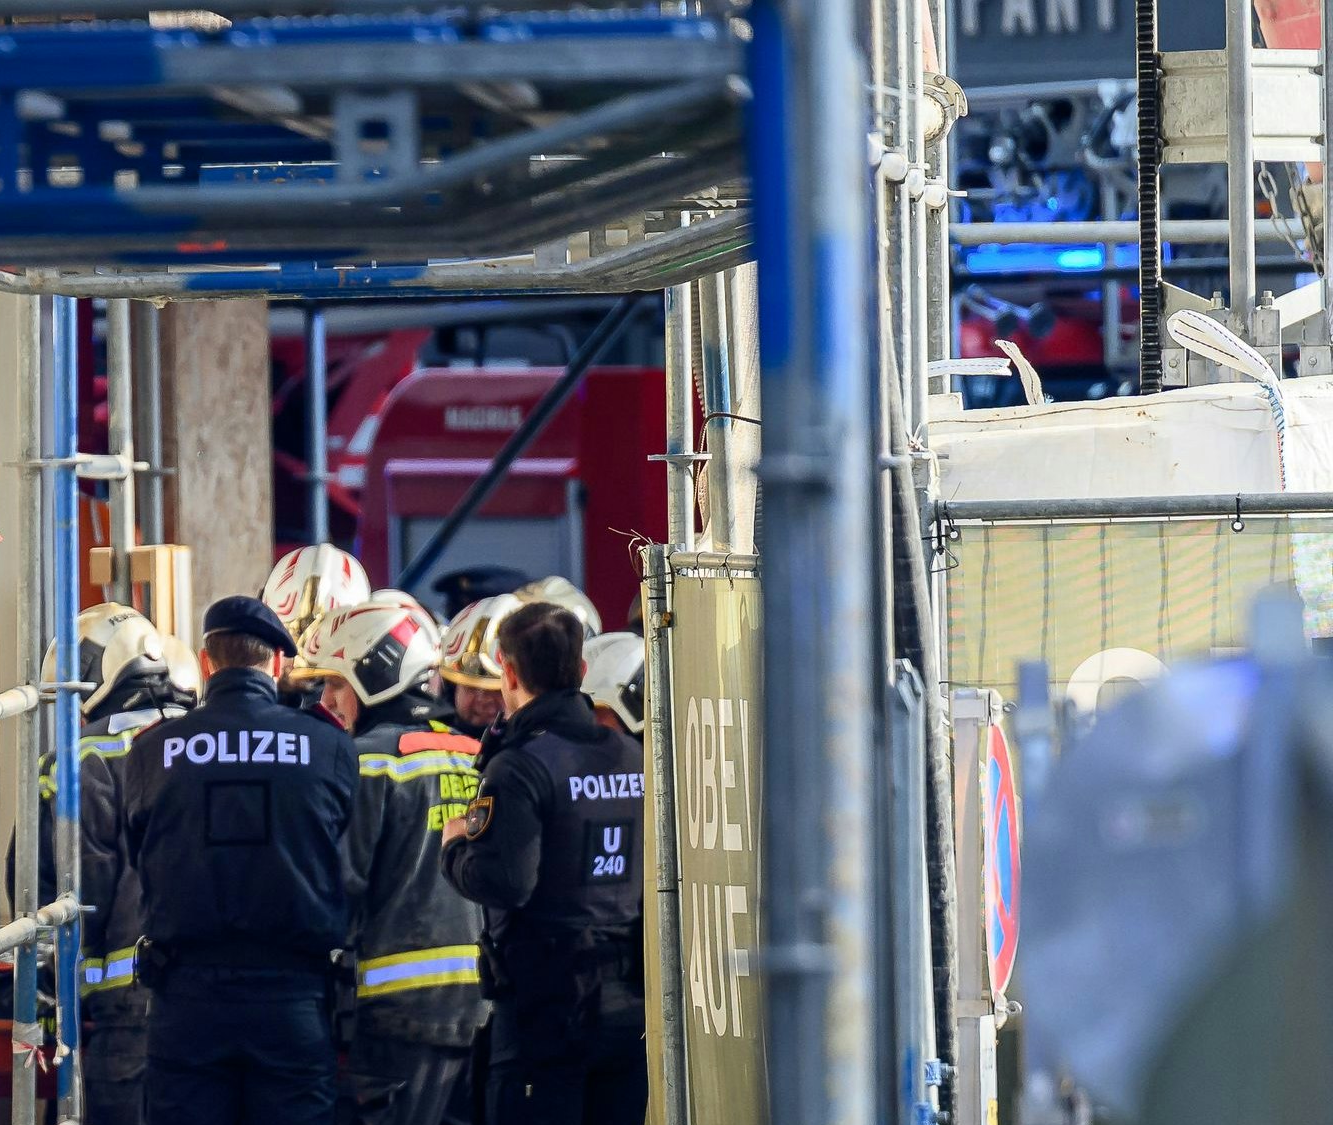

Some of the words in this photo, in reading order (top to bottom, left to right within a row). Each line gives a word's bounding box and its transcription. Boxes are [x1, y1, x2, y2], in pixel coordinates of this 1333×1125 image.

[163, 730, 311, 769] POLIZEI
[603, 826, 622, 853] U
[593, 855, 625, 876] 240
[689, 881, 749, 1037] AUF
